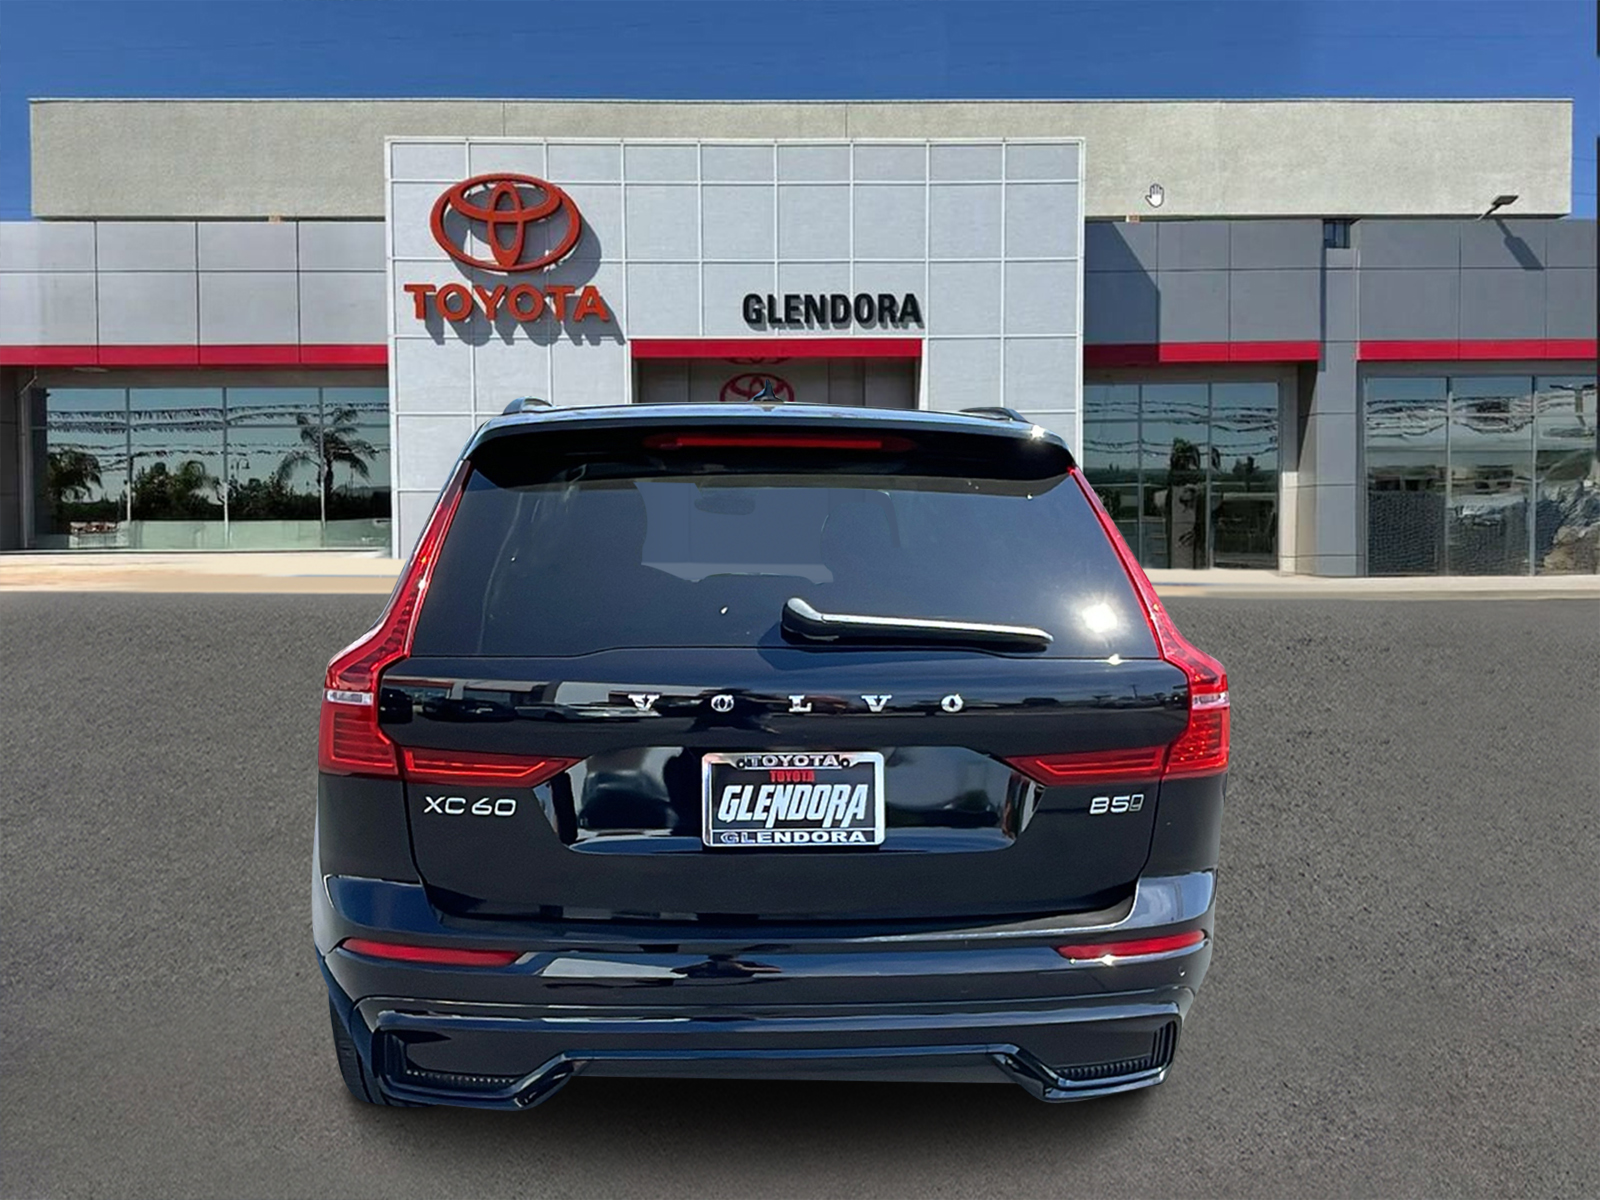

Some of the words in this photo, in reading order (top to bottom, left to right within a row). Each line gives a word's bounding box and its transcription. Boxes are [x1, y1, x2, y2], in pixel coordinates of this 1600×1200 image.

[404, 284, 610, 323] TOYOTA
[743, 293, 922, 325] GLENDORA
[628, 694, 964, 713] VOLVO
[748, 754, 839, 767] TOYOTA
[769, 770, 816, 782] TOYOTA
[717, 784, 868, 828] GLENDORA
[720, 831, 866, 843] GLENDORA
